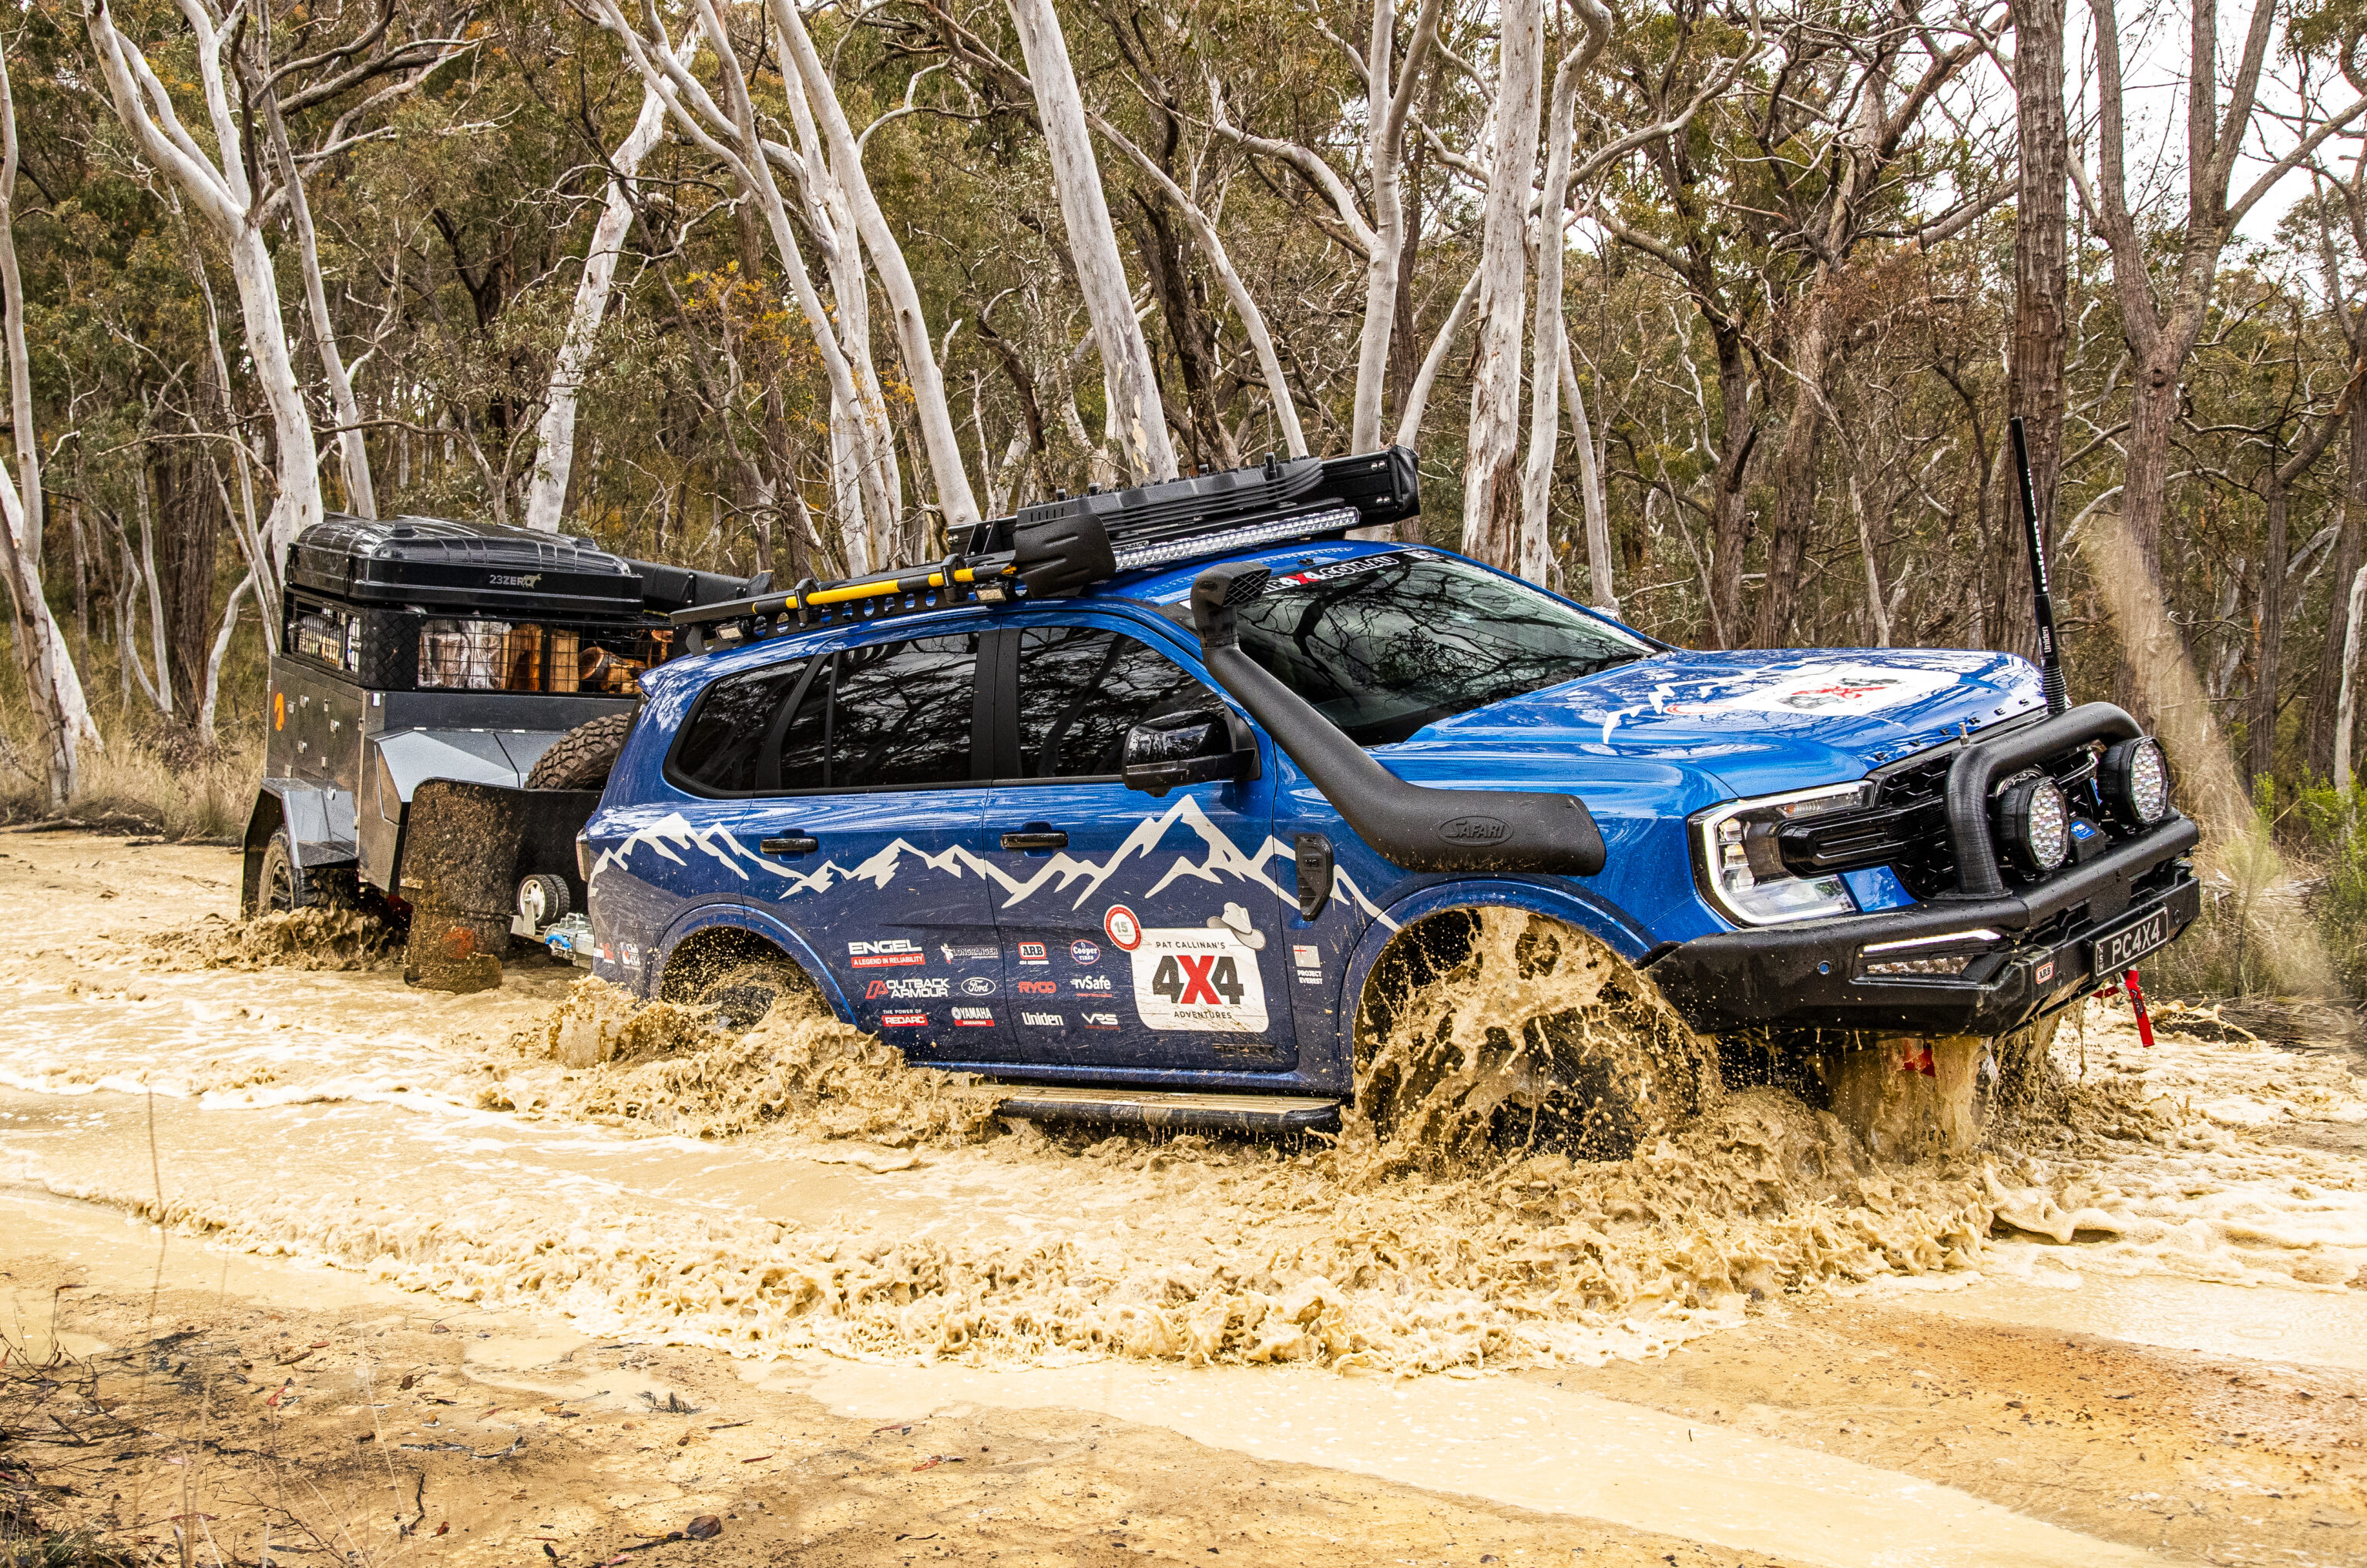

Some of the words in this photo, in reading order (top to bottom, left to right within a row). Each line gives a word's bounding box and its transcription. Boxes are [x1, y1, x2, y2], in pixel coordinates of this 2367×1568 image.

[2042, 626, 2052, 653] Uniden
[1875, 698, 2030, 761] EVERES
[1445, 821, 1505, 838] SAFARI
[848, 939, 923, 955] ENGEL
[2112, 917, 2161, 965] PC4X4
[1022, 946, 1043, 955] ARB
[1073, 945, 1098, 955] Cooper
[858, 957, 882, 965] LEGEND
[889, 955, 923, 964] RELIABILITY
[2039, 966, 2052, 980] ARB
[886, 978, 951, 989] OUTBACK
[968, 979, 989, 992] Ford
[1152, 955, 1244, 1005] 4X4
[1298, 976, 1323, 985] EVEREST
[891, 988, 948, 999] ARMOUR
[1019, 981, 1057, 994] RYCO
[959, 1007, 993, 1019] YAMAHA
[1022, 1012, 1064, 1026] Uniden
[1081, 1012, 1119, 1025] VRS
[1174, 1011, 1232, 1019] ADVENTURES
[885, 1016, 925, 1025] REDARC
